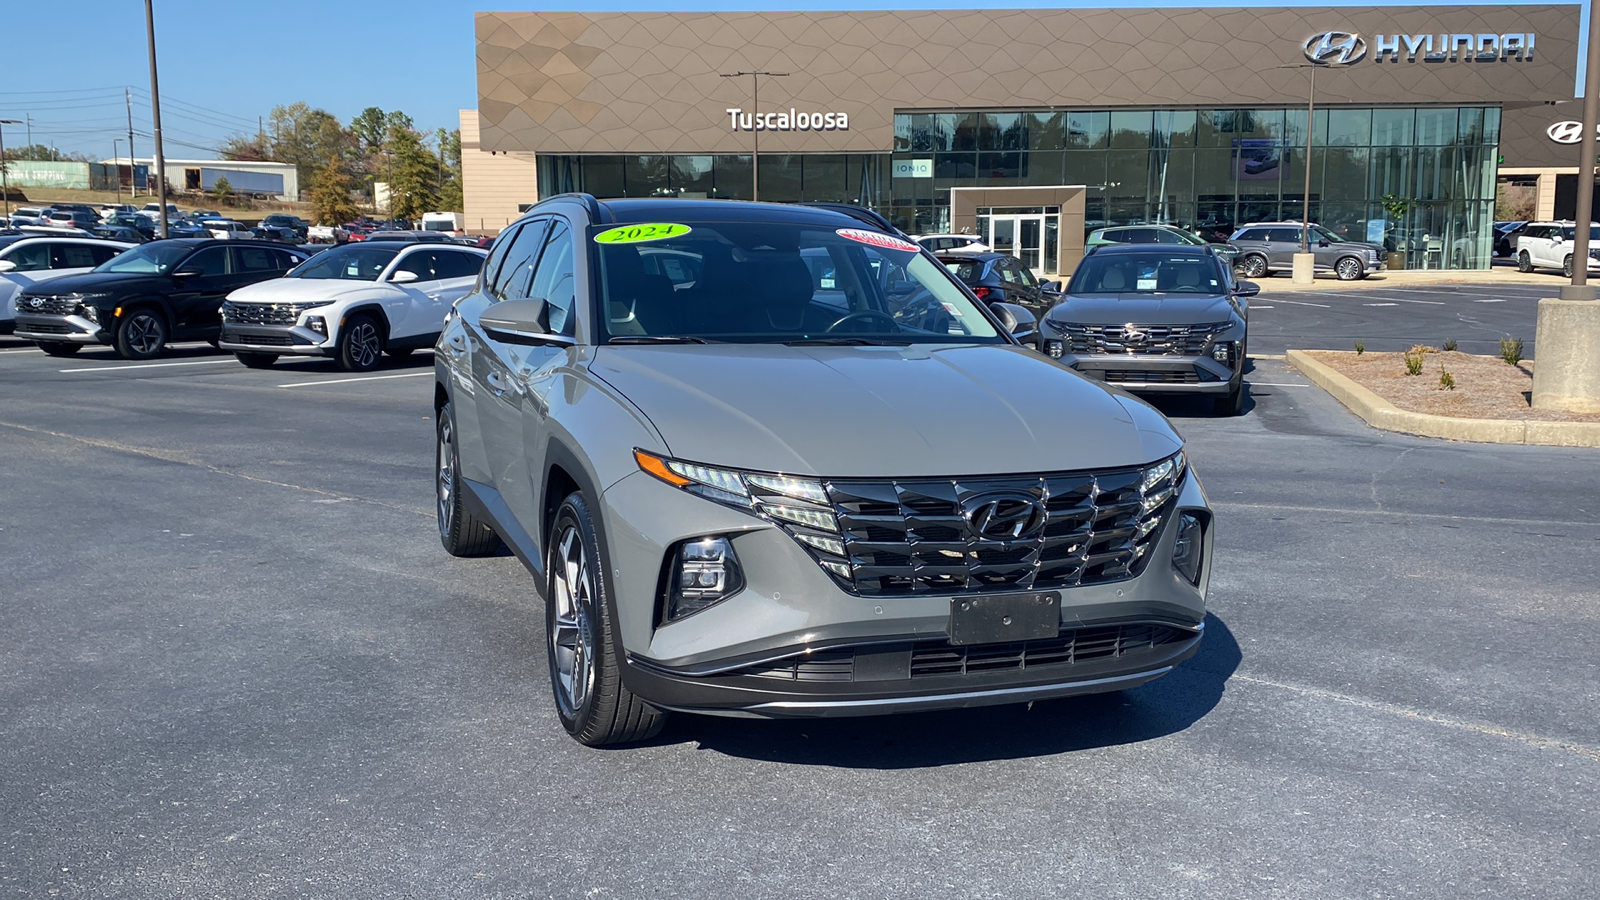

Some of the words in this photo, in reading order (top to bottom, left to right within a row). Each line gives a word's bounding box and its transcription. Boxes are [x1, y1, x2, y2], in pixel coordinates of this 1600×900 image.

[1375, 33, 1535, 61] HYUNDAI
[726, 108, 848, 129] Tuscaloosa
[611, 225, 674, 241] 2024
